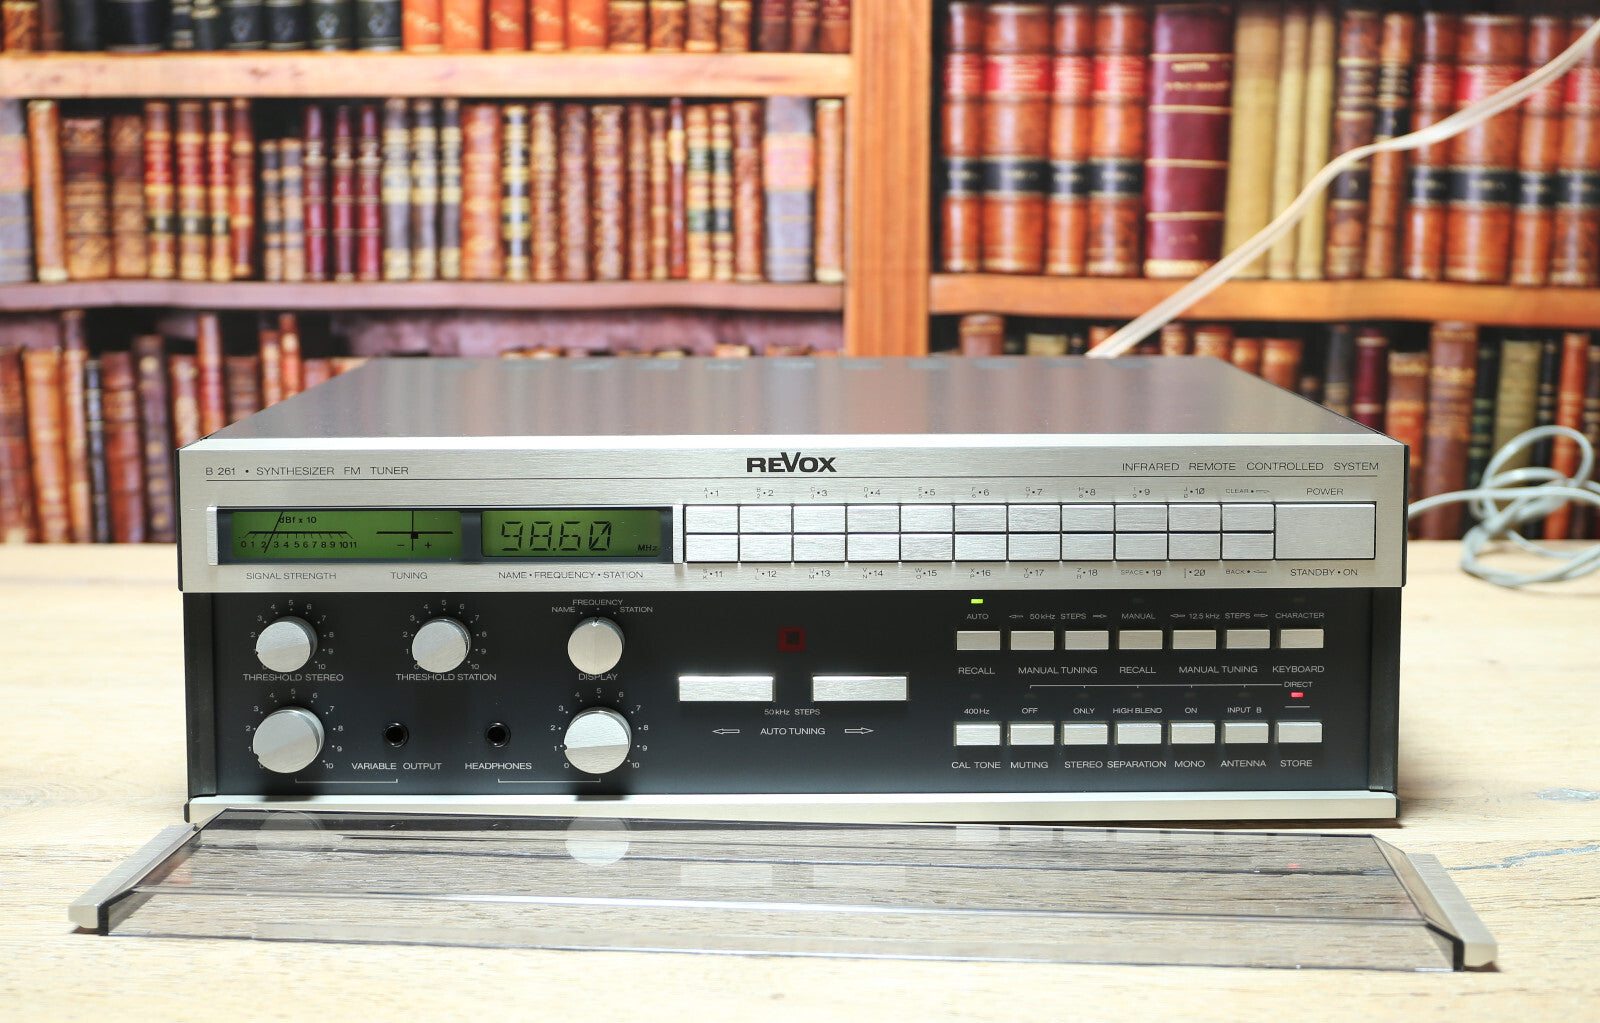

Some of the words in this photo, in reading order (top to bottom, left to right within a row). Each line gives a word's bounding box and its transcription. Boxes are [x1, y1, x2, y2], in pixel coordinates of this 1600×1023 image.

[747, 452, 836, 472] REVOX
[1122, 463, 1179, 471] INFRARED
[1189, 463, 1236, 471] REMOTE
[1247, 462, 1324, 471] CONTROLLED
[1333, 462, 1379, 471] SYSTEM
[205, 467, 214, 476] B
[218, 467, 236, 476] 261
[256, 467, 335, 476] SYNTHESIZER
[344, 466, 362, 476] FM
[370, 466, 409, 475] TUNER
[1306, 488, 1344, 496] POWER
[1290, 568, 1335, 577] STANDBY
[1343, 568, 1358, 576] ON
[958, 667, 995, 675] RECALL
[465, 762, 532, 770] HEADPHONES
[1010, 761, 1048, 769] MUTING
[1175, 760, 1205, 768] MONO
